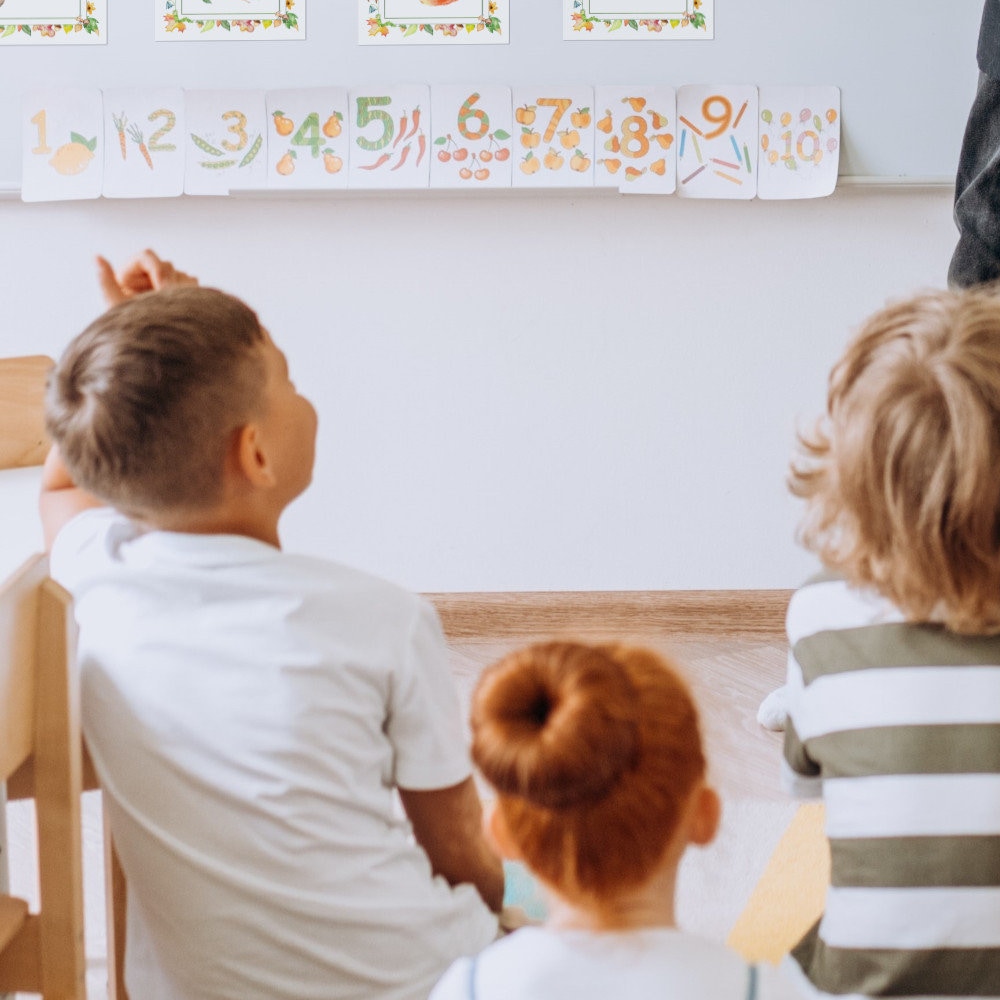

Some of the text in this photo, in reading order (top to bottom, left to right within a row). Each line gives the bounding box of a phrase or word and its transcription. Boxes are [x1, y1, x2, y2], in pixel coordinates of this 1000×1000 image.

[31, 109, 52, 155] 1
[148, 108, 177, 152] 2
[221, 110, 248, 152] 3
[290, 112, 327, 158] 4
[356, 96, 395, 151] 5
[457, 92, 490, 140] 6
[536, 98, 573, 143] 7
[620, 115, 650, 158] 8
[701, 94, 733, 140] 9
[782, 130, 820, 161] 10
